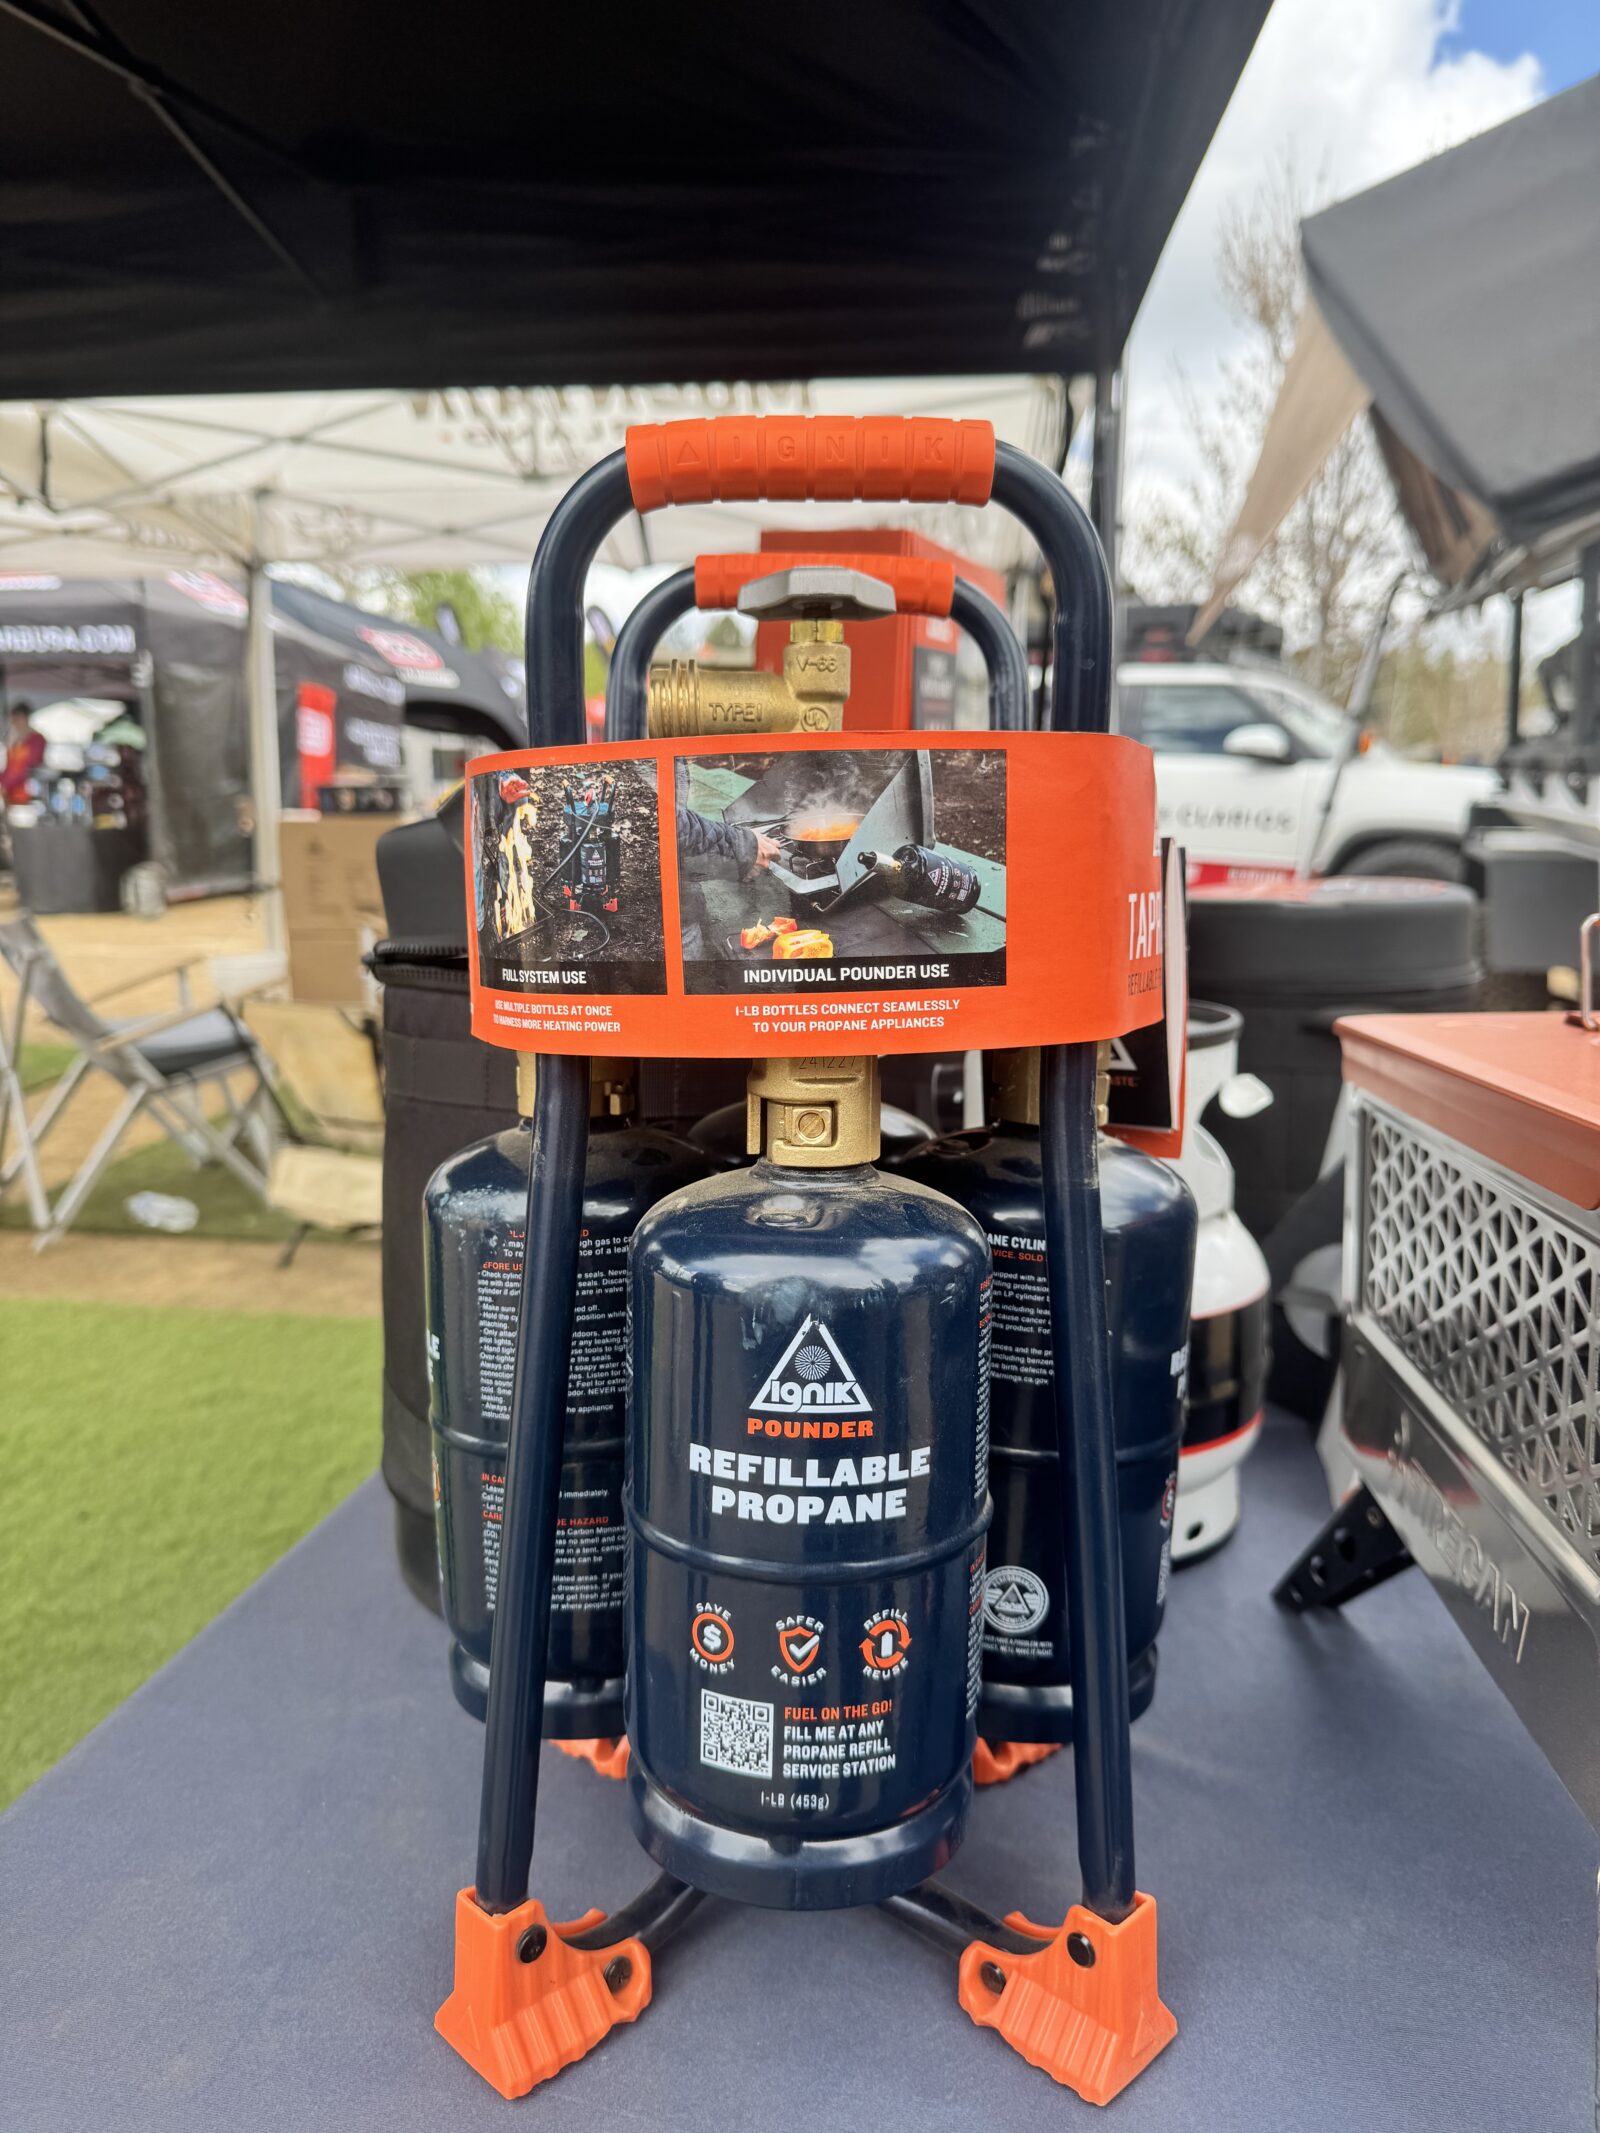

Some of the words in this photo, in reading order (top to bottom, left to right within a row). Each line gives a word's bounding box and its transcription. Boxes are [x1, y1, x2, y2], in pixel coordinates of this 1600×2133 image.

[732, 435, 944, 464] IGNIK
[502, 968, 518, 983] FULL
[518, 969, 560, 984] SYSTEM
[562, 970, 587, 985] USE
[744, 968, 837, 983] INDIVIDUAL
[840, 965, 916, 980] POUNDER
[920, 964, 950, 978] USE
[531, 1004, 568, 1015] BOTTLES
[571, 1006, 583, 1015] AT
[585, 1006, 612, 1016] ONCE
[762, 1004, 818, 1016] BOTTLES
[820, 1003, 879, 1015] CONNECT
[882, 999, 960, 1012] SEAMLESSLY
[522, 1018, 542, 1029] MORE
[543, 1020, 583, 1031] HEATING
[584, 1022, 621, 1032] POWER
[753, 1022, 769, 1033] TO
[772, 1021, 806, 1032] YOUR
[809, 1019, 867, 1032] PROPANE
[870, 1016, 945, 1030] APPLIANCES
[595, 1239, 610, 1248] gas
[595, 1247, 603, 1255] of
[1018, 1252, 1044, 1262] SOLD
[1004, 1290, 1014, 1298] LP
[1015, 1293, 1045, 1301] cylinder
[576, 1313, 606, 1322] position
[997, 1312, 1019, 1321] cause
[1021, 1316, 1046, 1324] cancer
[1002, 1304, 1035, 1315] including
[1014, 1346, 1029, 1354] and
[1001, 1363, 1018, 1371] birth
[1020, 1366, 1047, 1375] defects
[588, 1385, 616, 1395] NEVER
[578, 1403, 614, 1414] appliance
[747, 1417, 873, 1438] POUNDER
[689, 1442, 931, 1487] REFILLABLE
[711, 1485, 907, 1524] PROPANE
[569, 1516, 609, 1526] HAZARD
[695, 1602, 732, 1621] SAVE
[863, 1608, 908, 1631] REFILL
[775, 1615, 824, 1635] SAFER
[689, 1648, 735, 1675] MONEY
[862, 1657, 909, 1680] REUSE
[770, 1665, 827, 1687] EASIER
[784, 1706, 817, 1721] FUEL
[821, 1707, 840, 1720] ON
[843, 1703, 868, 1718] THE
[871, 1699, 893, 1716] GO!
[784, 1725, 811, 1741] FILL
[815, 1725, 835, 1742] ME
[838, 1723, 855, 1740] AT
[858, 1720, 884, 1738] ANY
[783, 1744, 845, 1761] PROPANE
[849, 1737, 892, 1758] REFILL
[783, 1762, 839, 1779] SERVICE
[842, 1754, 896, 1778] STATION
[790, 1793, 829, 1812] (453g)
